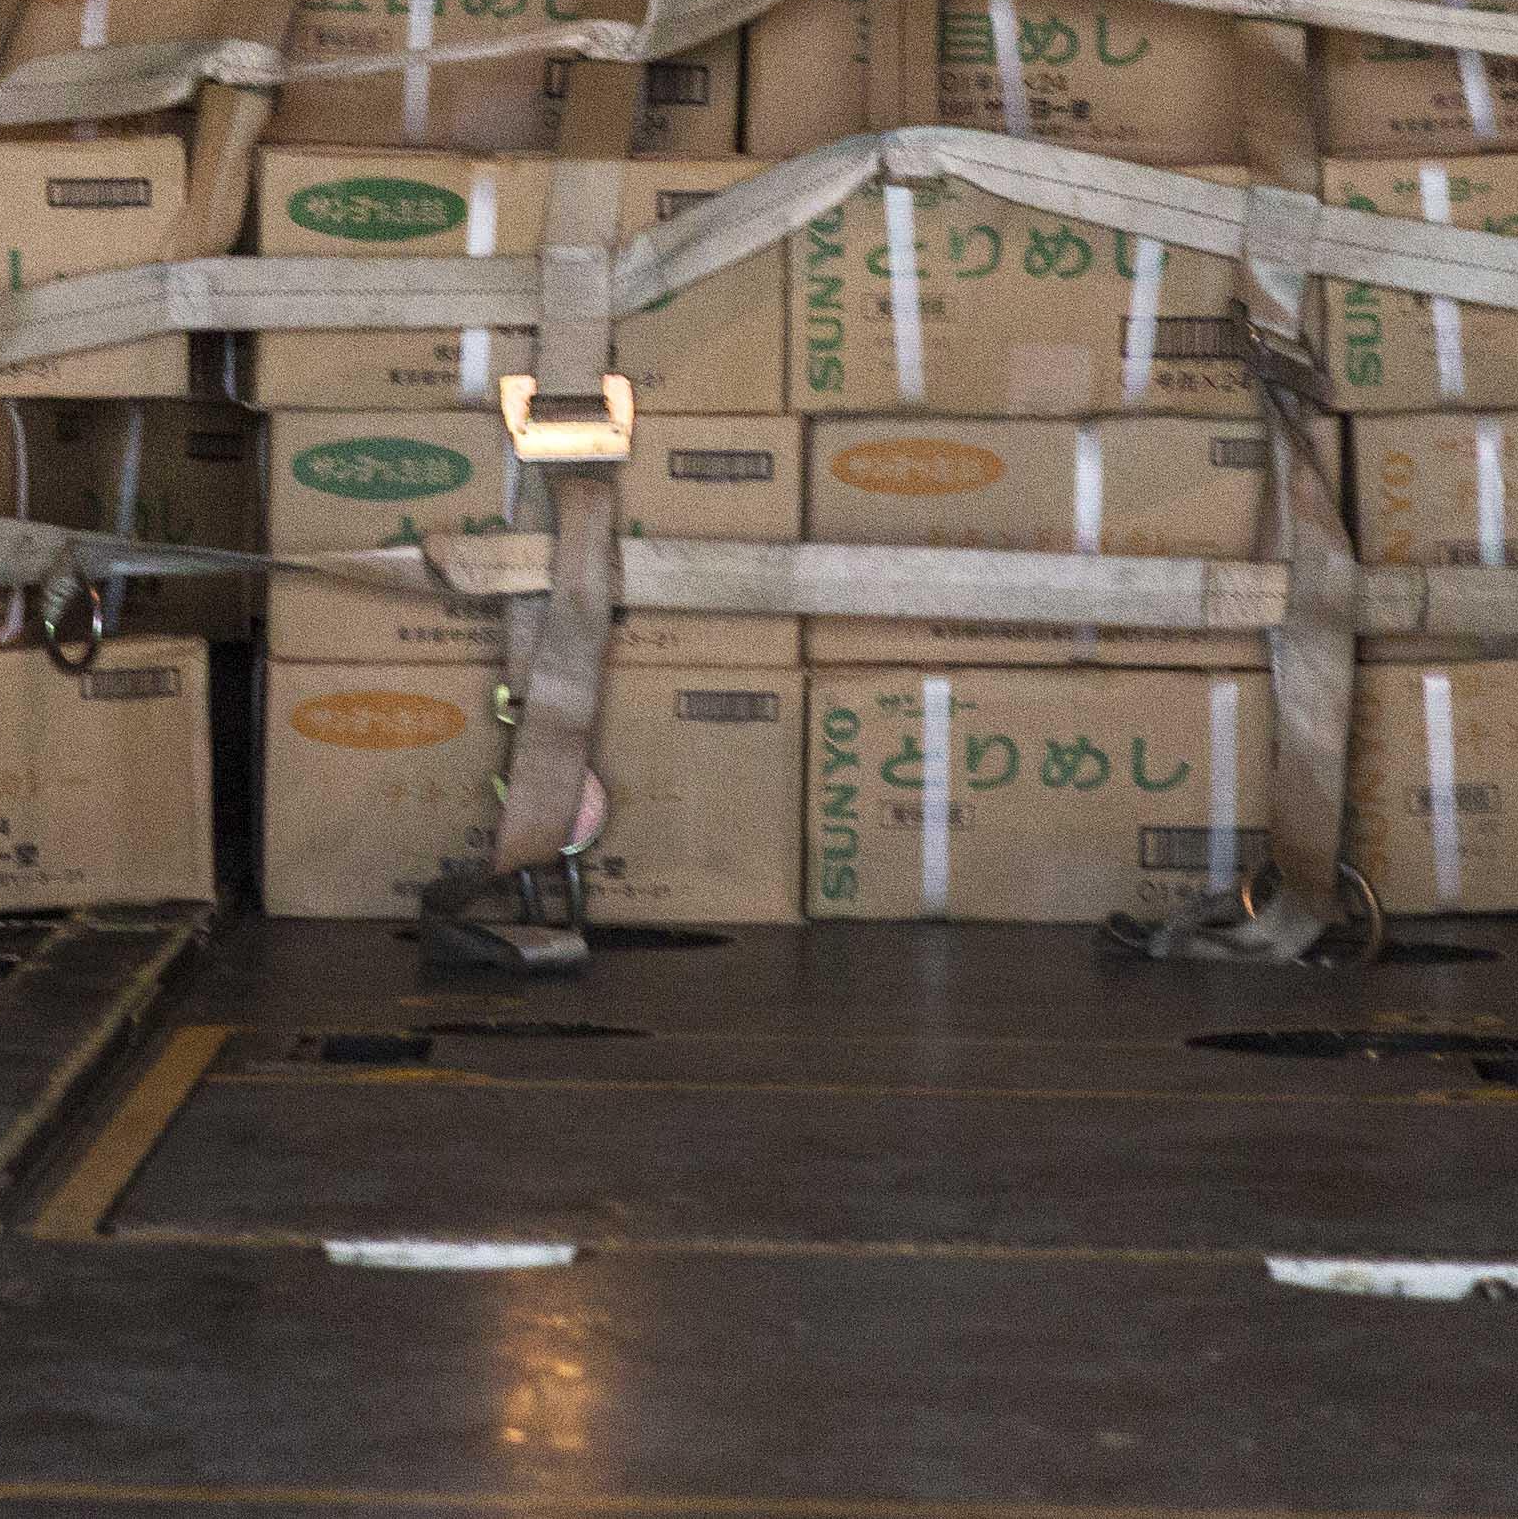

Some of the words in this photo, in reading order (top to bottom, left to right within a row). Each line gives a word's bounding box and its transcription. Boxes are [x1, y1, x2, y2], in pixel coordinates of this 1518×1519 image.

[820, 706, 862, 904] SUNYO
[879, 732, 1192, 792] とりめし
